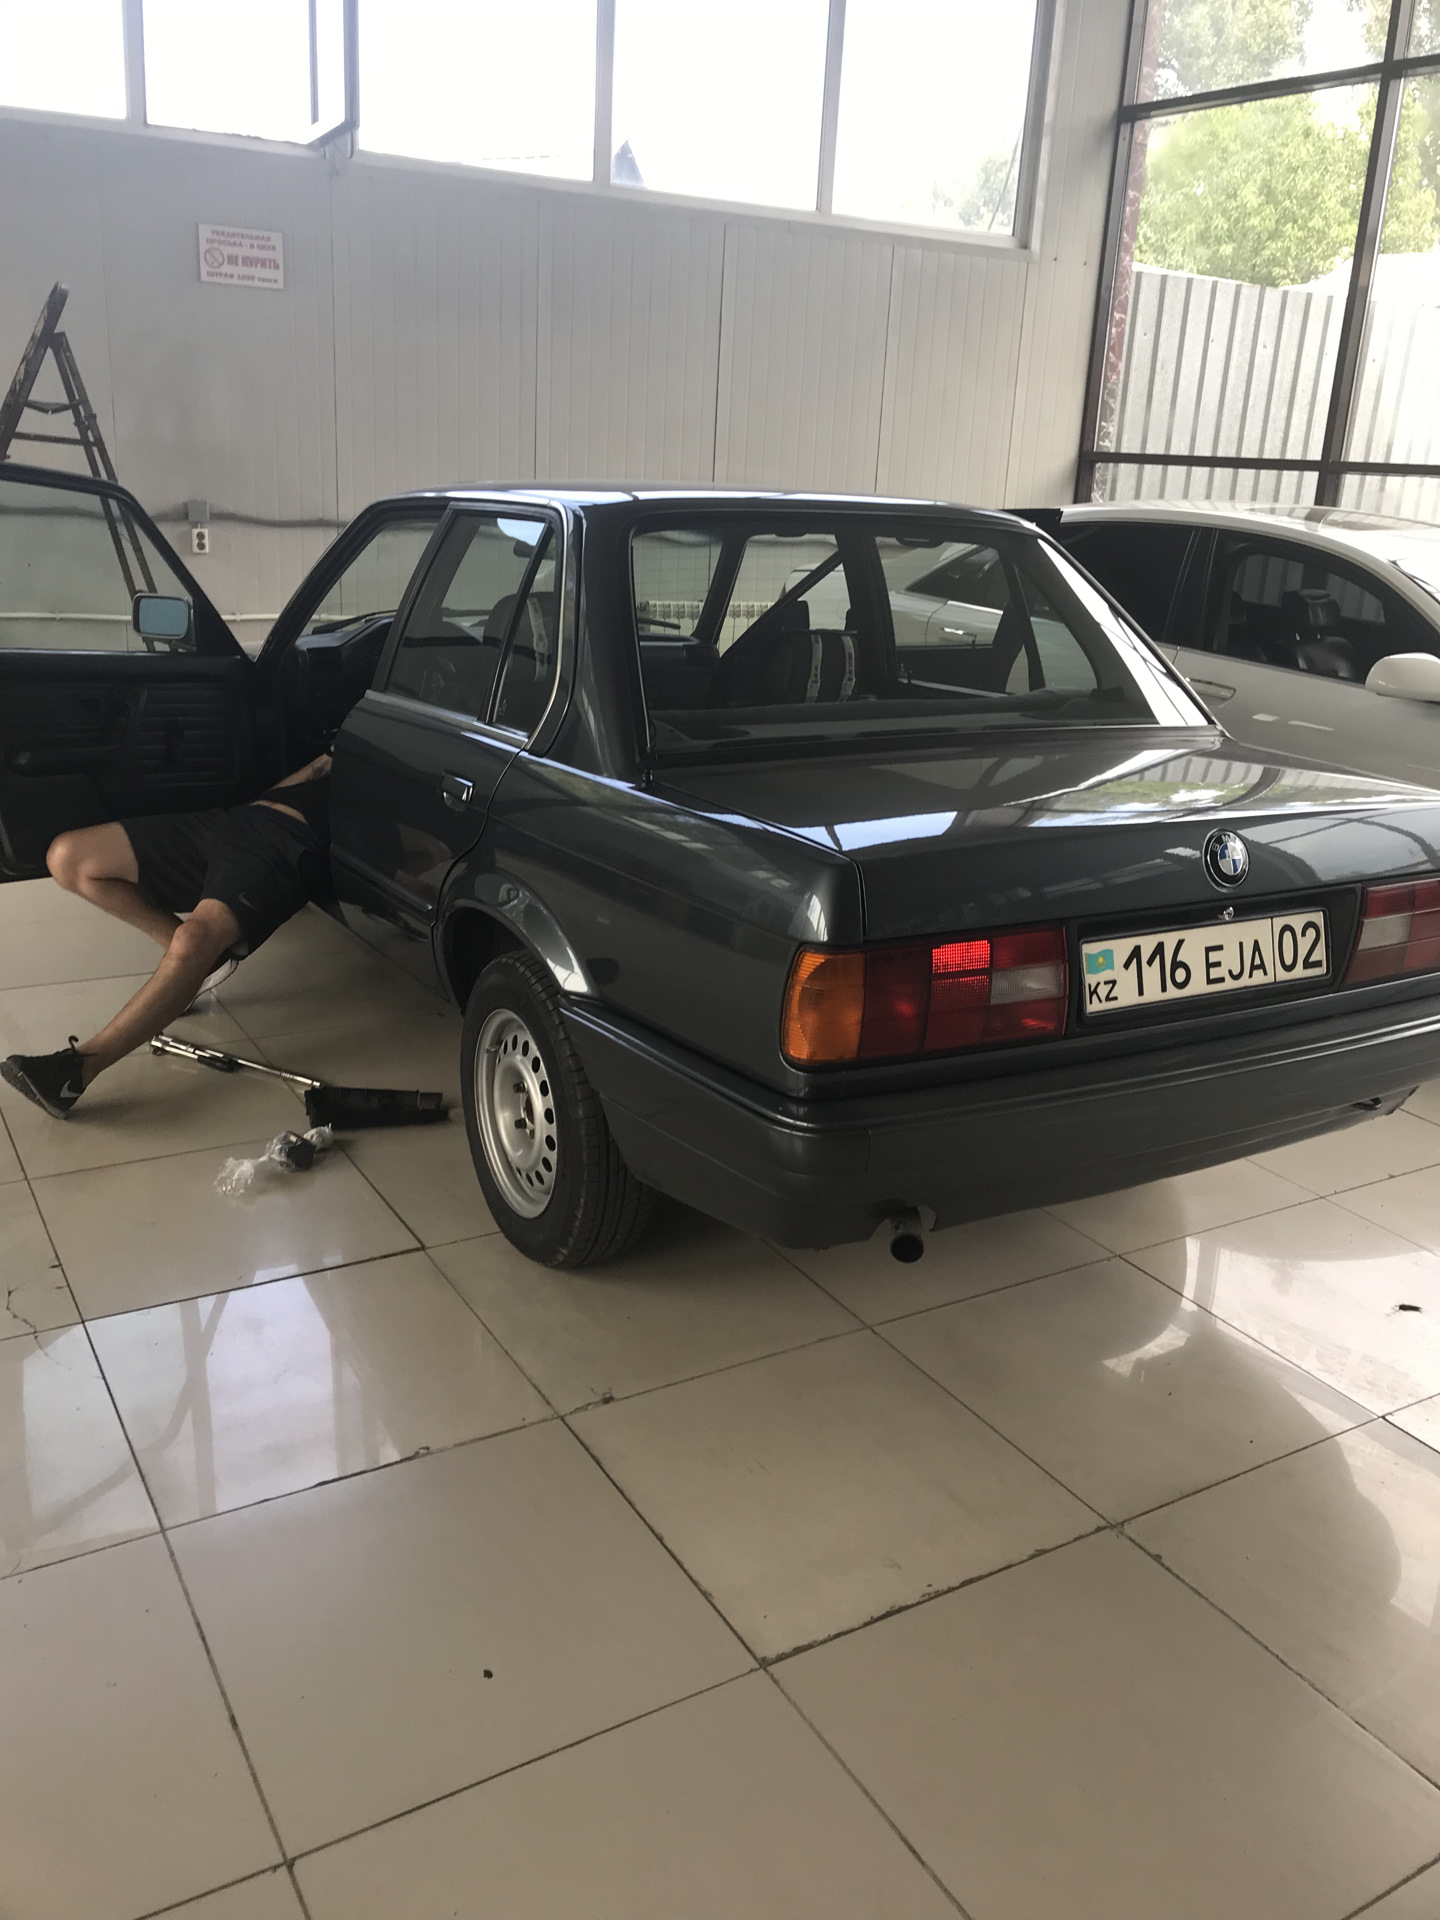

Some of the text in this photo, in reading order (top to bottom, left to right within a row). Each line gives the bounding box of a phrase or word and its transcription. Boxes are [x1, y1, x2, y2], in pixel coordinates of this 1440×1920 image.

[226, 253, 280, 271] НЕ КУРИТЬ
[206, 269, 235, 280] ШТРАФ
[1122, 920, 1323, 997] 116 EJA 02
[1088, 979, 1119, 1005] KZ
